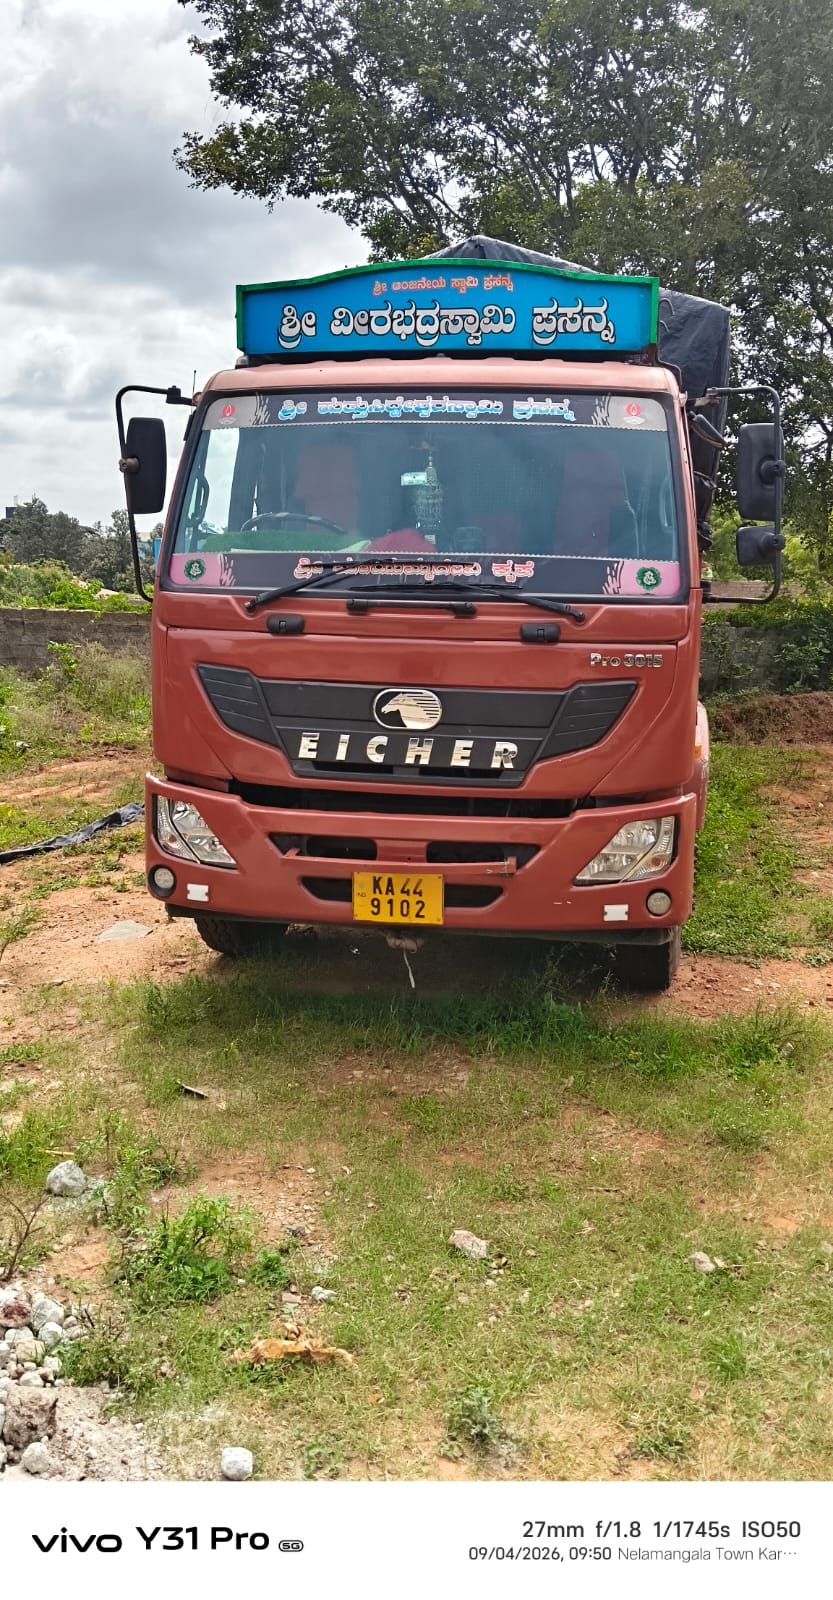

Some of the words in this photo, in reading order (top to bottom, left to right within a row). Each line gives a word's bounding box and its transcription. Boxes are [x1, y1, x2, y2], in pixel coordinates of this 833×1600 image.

[373, 280, 388, 296] ಶ್ರೀ
[451, 275, 479, 293] ಸ್ವಾಮಿ
[483, 272, 514, 292] ಪ್ರಸನ್ನ
[278, 304, 317, 349] ಶ್ರೀ
[330, 299, 516, 347] ವೀರಭದ್ರಸ್ವಾಮಿ
[532, 297, 616, 345] ಪ್ರಸನ್ನ
[278, 400, 307, 420] ಶ್ರೀ
[513, 397, 576, 421] ಪ್ರಸನ್ನ
[492, 560, 535, 583] ಕೃಪೆ
[590, 652, 621, 667] Pro
[623, 653, 664, 668] 3015
[298, 732, 518, 769] EICHER
[373, 876, 395, 896] KA
[400, 878, 424, 897] 44
[371, 897, 426, 919] 9102
